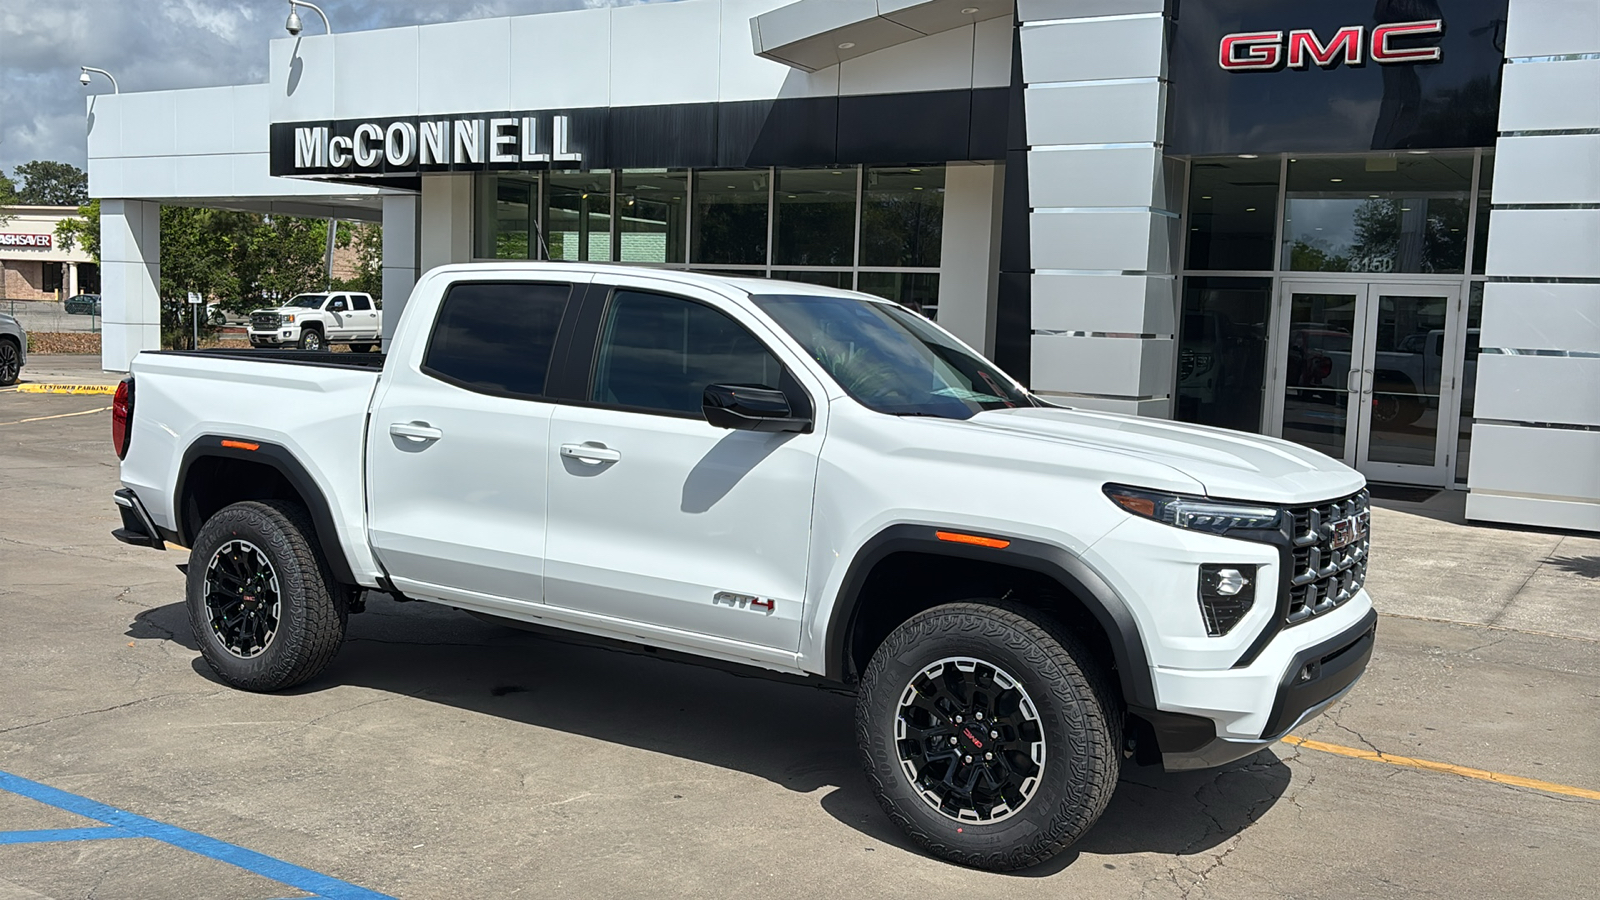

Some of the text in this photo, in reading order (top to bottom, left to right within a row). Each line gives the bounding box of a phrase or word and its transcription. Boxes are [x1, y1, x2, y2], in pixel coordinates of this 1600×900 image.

[1218, 18, 1443, 70] GMC
[294, 115, 583, 169] McCONNELL
[1350, 256, 1393, 272] 3150
[1329, 509, 1370, 550] GMC
[712, 590, 776, 617] AT4
[962, 727, 983, 749] GMC
